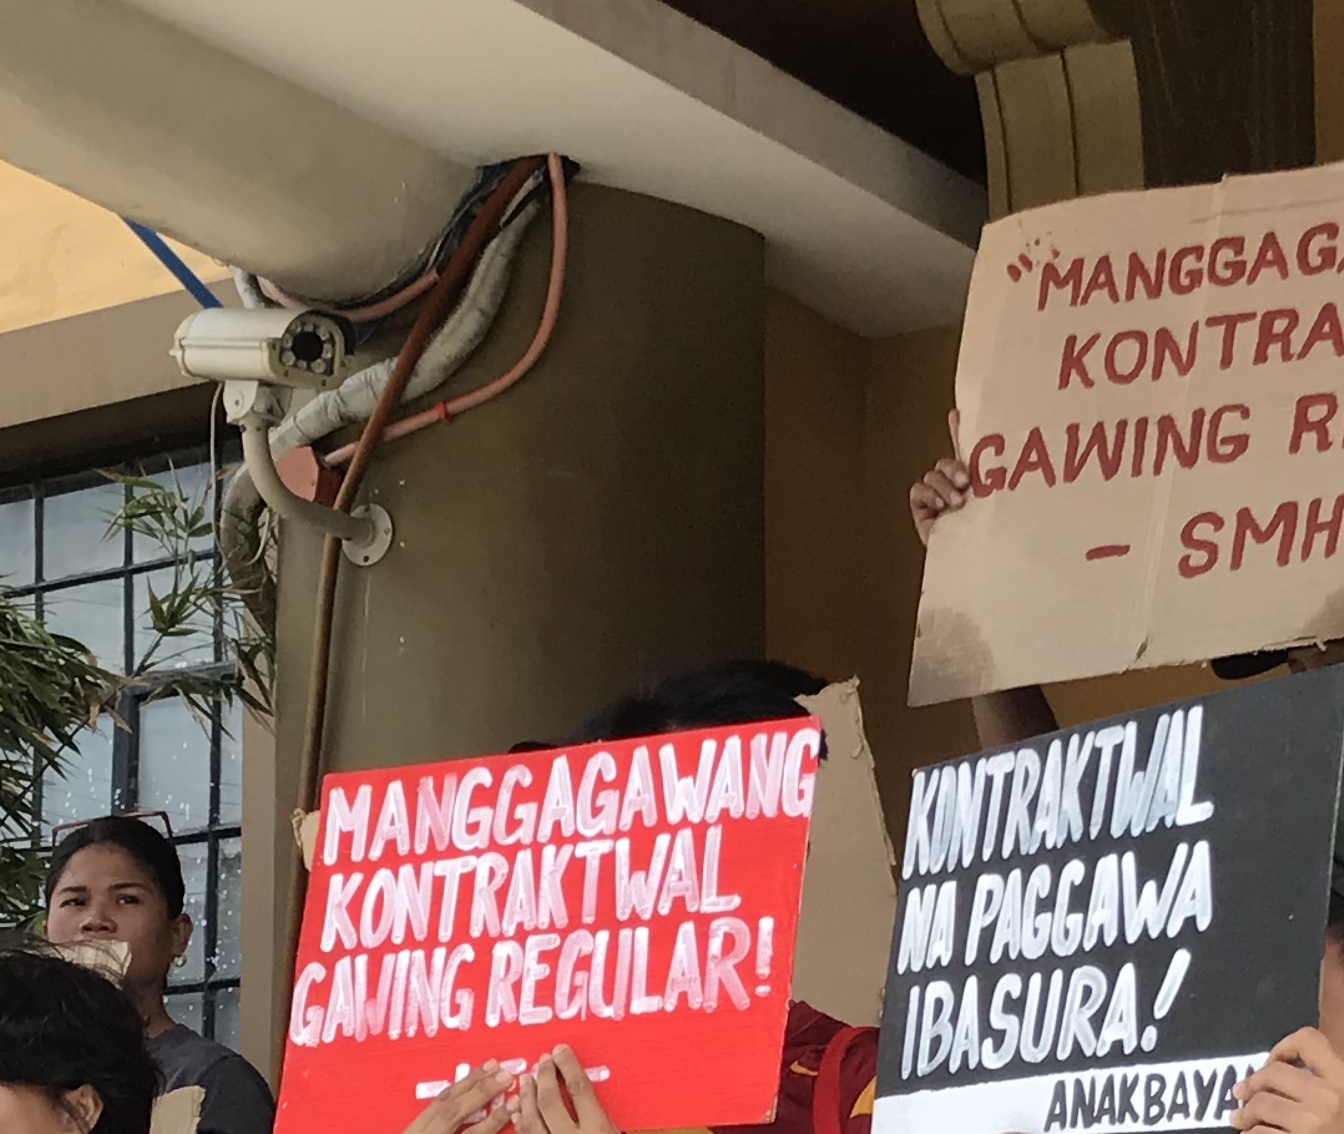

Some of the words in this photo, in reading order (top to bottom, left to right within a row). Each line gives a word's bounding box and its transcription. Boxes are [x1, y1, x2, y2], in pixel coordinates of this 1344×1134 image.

[967, 406, 1251, 498] GAWING
[323, 728, 820, 866] MANGGAGAWANG
[902, 705, 1214, 880] KONTRAKTWAL
[320, 825, 742, 952] KONTRAKTWAL
[897, 880, 957, 975] NA
[965, 840, 1213, 965] PAGGAWA
[289, 943, 475, 1047] GAWING
[485, 917, 774, 1028] REGULAR!
[901, 948, 1191, 1080] IBASURA!
[1043, 1064, 1255, 1132] ANAKBAYA
